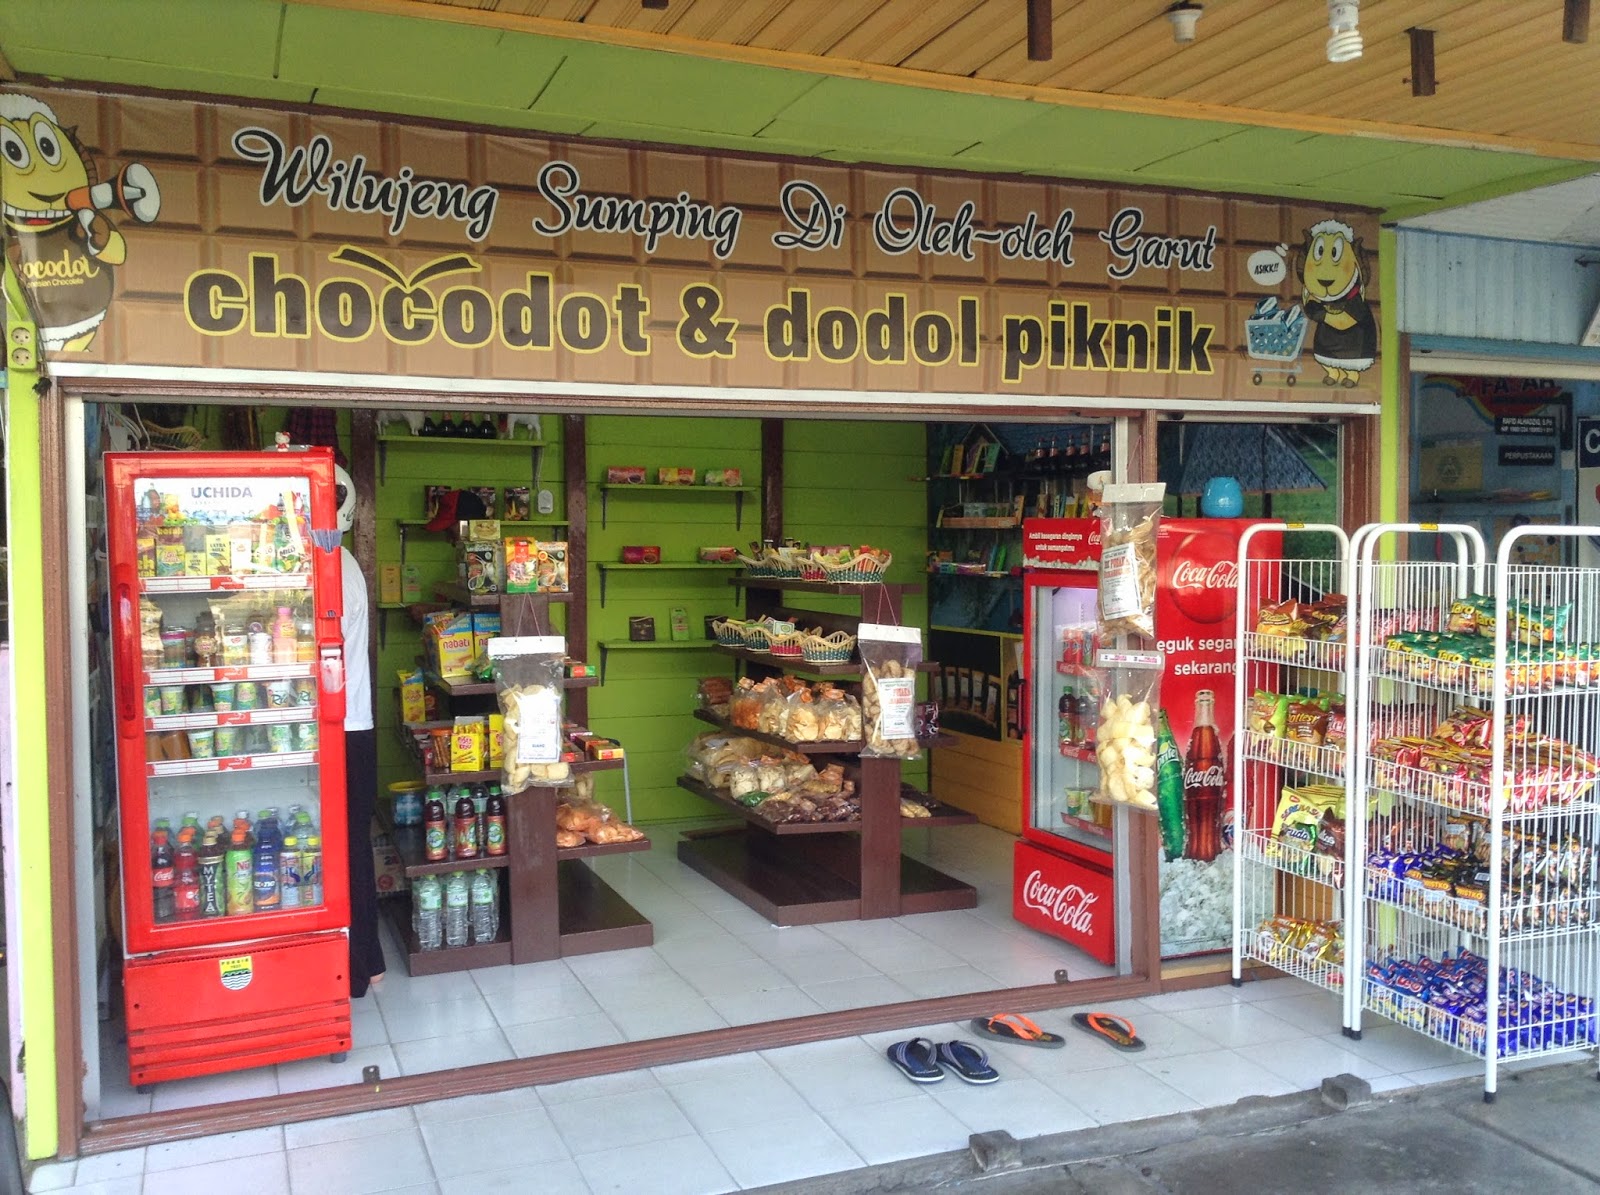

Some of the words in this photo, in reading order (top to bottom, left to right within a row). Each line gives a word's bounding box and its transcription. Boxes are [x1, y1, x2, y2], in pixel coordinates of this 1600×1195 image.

[232, 126, 499, 242] Wilujeng
[533, 160, 742, 259] Sumping
[771, 179, 846, 250] Di
[875, 187, 1076, 268] Oleh-oleh
[1099, 206, 1217, 279] Garut
[184, 246, 651, 357] chocodot
[676, 282, 740, 360] &
[763, 288, 978, 366] dodol
[1001, 301, 1214, 383] piknik
[191, 486, 253, 499] UCHIDA
[1172, 560, 1239, 589] Coca-Cola
[1451, 602, 1475, 614] Taro
[1516, 613, 1544, 633] Taro
[443, 638, 470, 649] nabati
[1156, 636, 1194, 654] eguk
[1386, 639, 1403, 651] Tar
[1437, 650, 1462, 665] Taro
[1184, 765, 1225, 790] Coca-Cola
[1023, 870, 1099, 933] Coca-Cola
